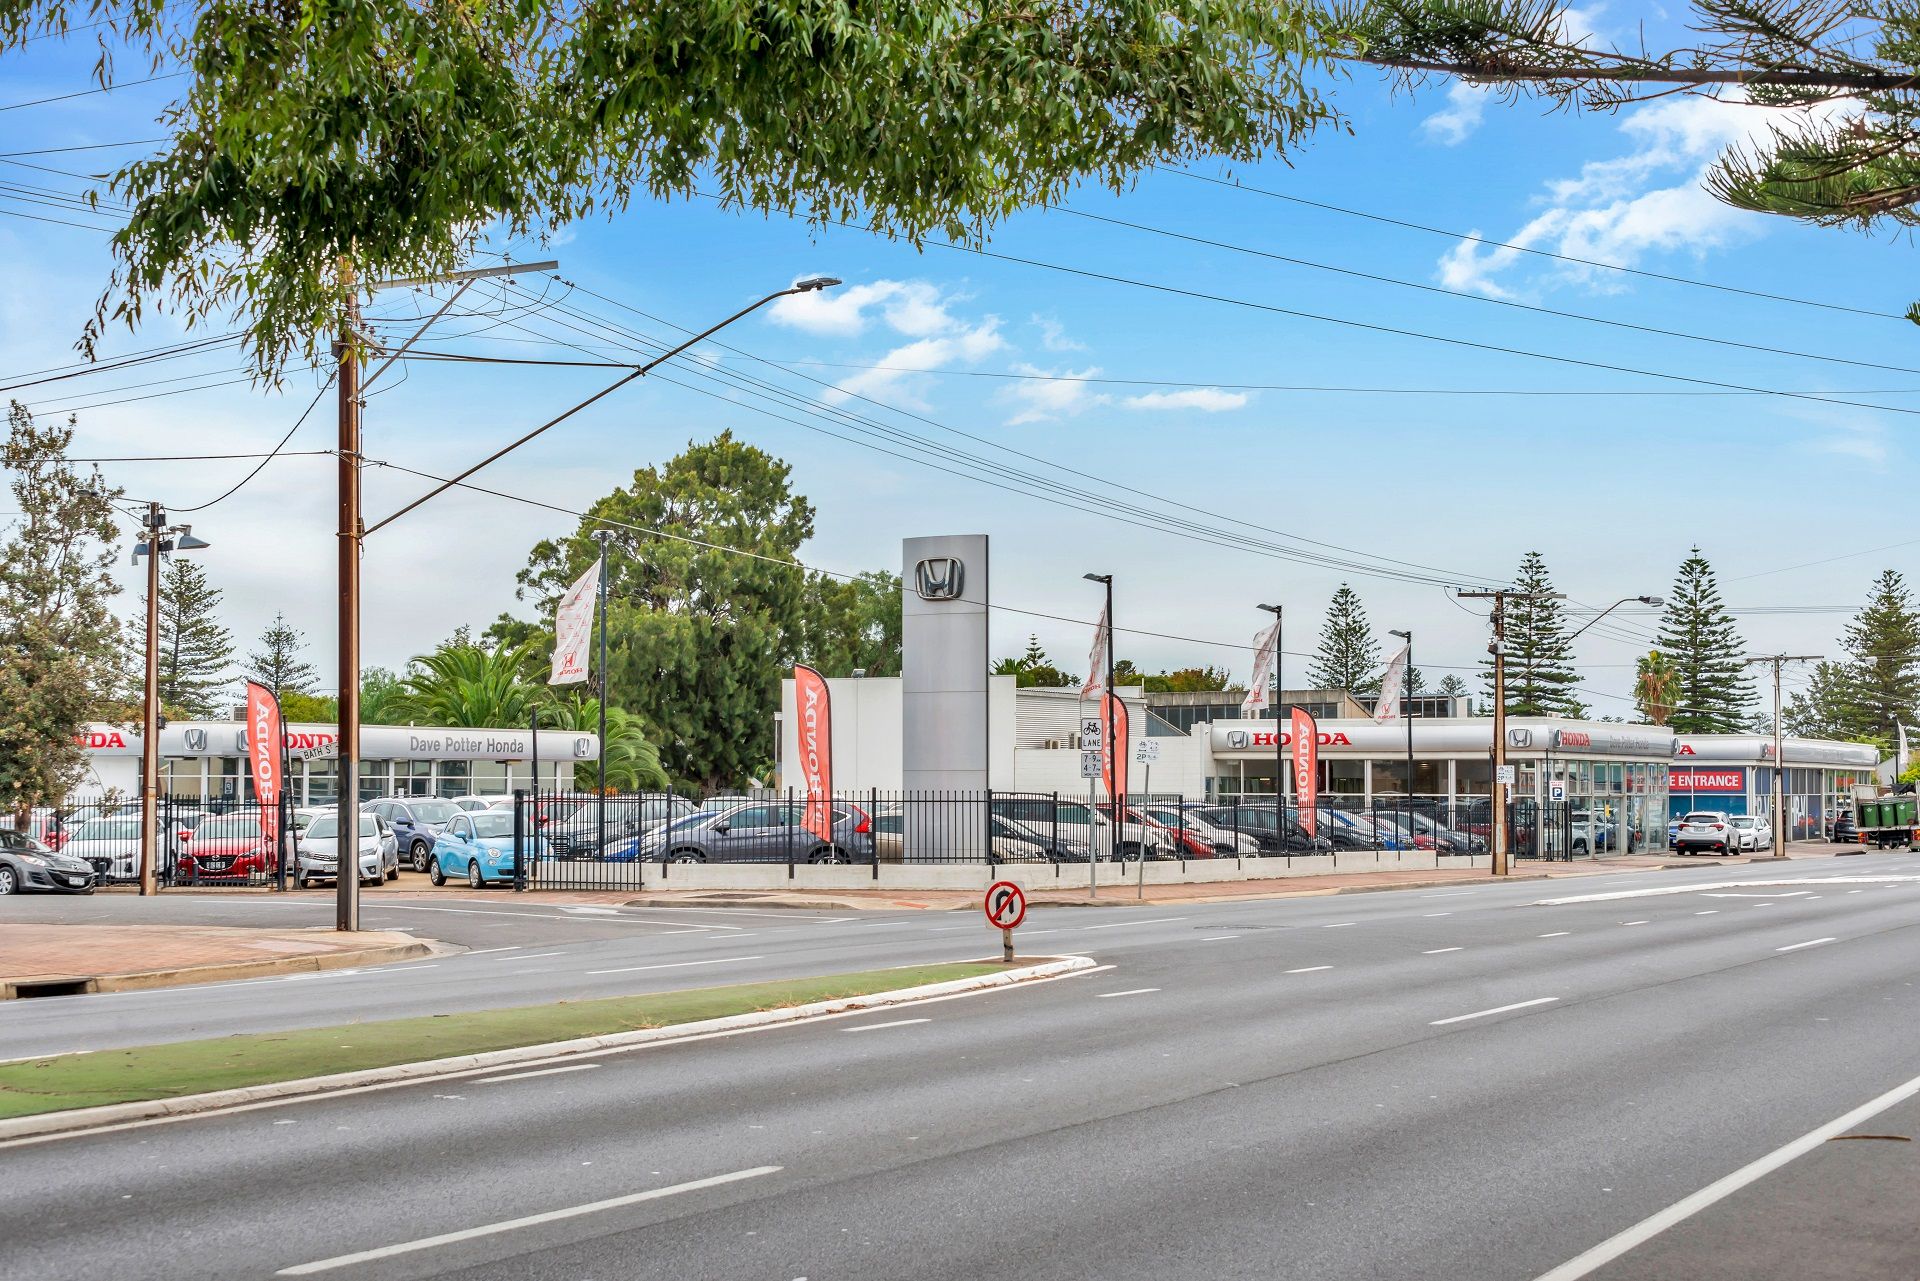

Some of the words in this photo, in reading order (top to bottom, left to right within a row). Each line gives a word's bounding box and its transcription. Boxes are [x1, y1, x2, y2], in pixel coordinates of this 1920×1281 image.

[282, 733, 338, 749] OND
[410, 736, 440, 752] Dave
[445, 737, 482, 752] Potter
[487, 738, 524, 753] Honda
[1083, 739, 1101, 747] LANE
[1252, 732, 1352, 746] HODA
[1561, 730, 1591, 747] HONDA
[304, 747, 323, 760] BATH
[1678, 775, 1739, 787] ENTRANCE
